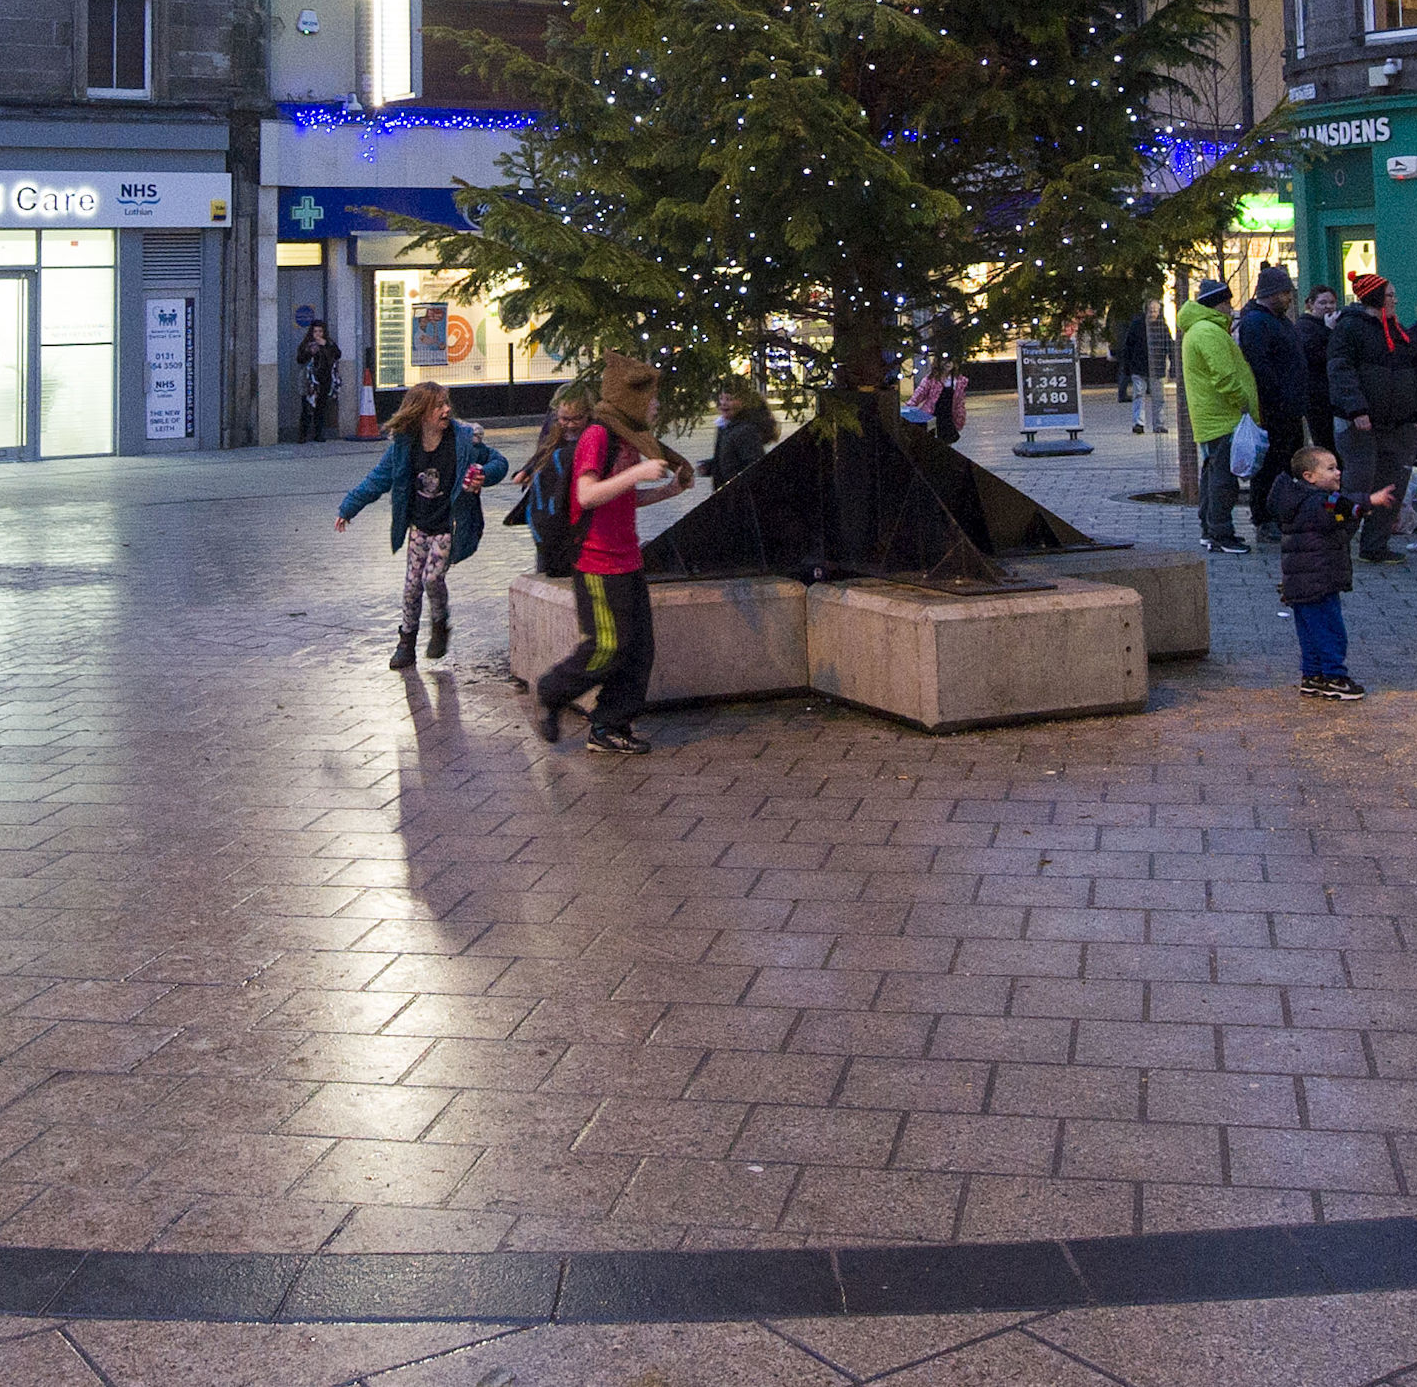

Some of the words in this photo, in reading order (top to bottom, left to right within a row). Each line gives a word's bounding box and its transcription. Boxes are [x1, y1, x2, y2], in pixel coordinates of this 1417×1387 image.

[120, 183, 159, 198] NHS
[16, 186, 96, 213] Care
[124, 207, 154, 217] Lothian
[1022, 347, 1046, 355] Travel
[1047, 346, 1074, 355] Money
[155, 352, 175, 360] 0131
[164, 361, 183, 370] 3509
[1023, 357, 1037, 365] 0%
[155, 381, 175, 389] NHS
[1025, 375, 1068, 389] 1.342
[1026, 391, 1069, 405] 1.480
[149, 417, 168, 425] SMILE
[170, 416, 181, 424] OF
[154, 425, 176, 433] LEITH
